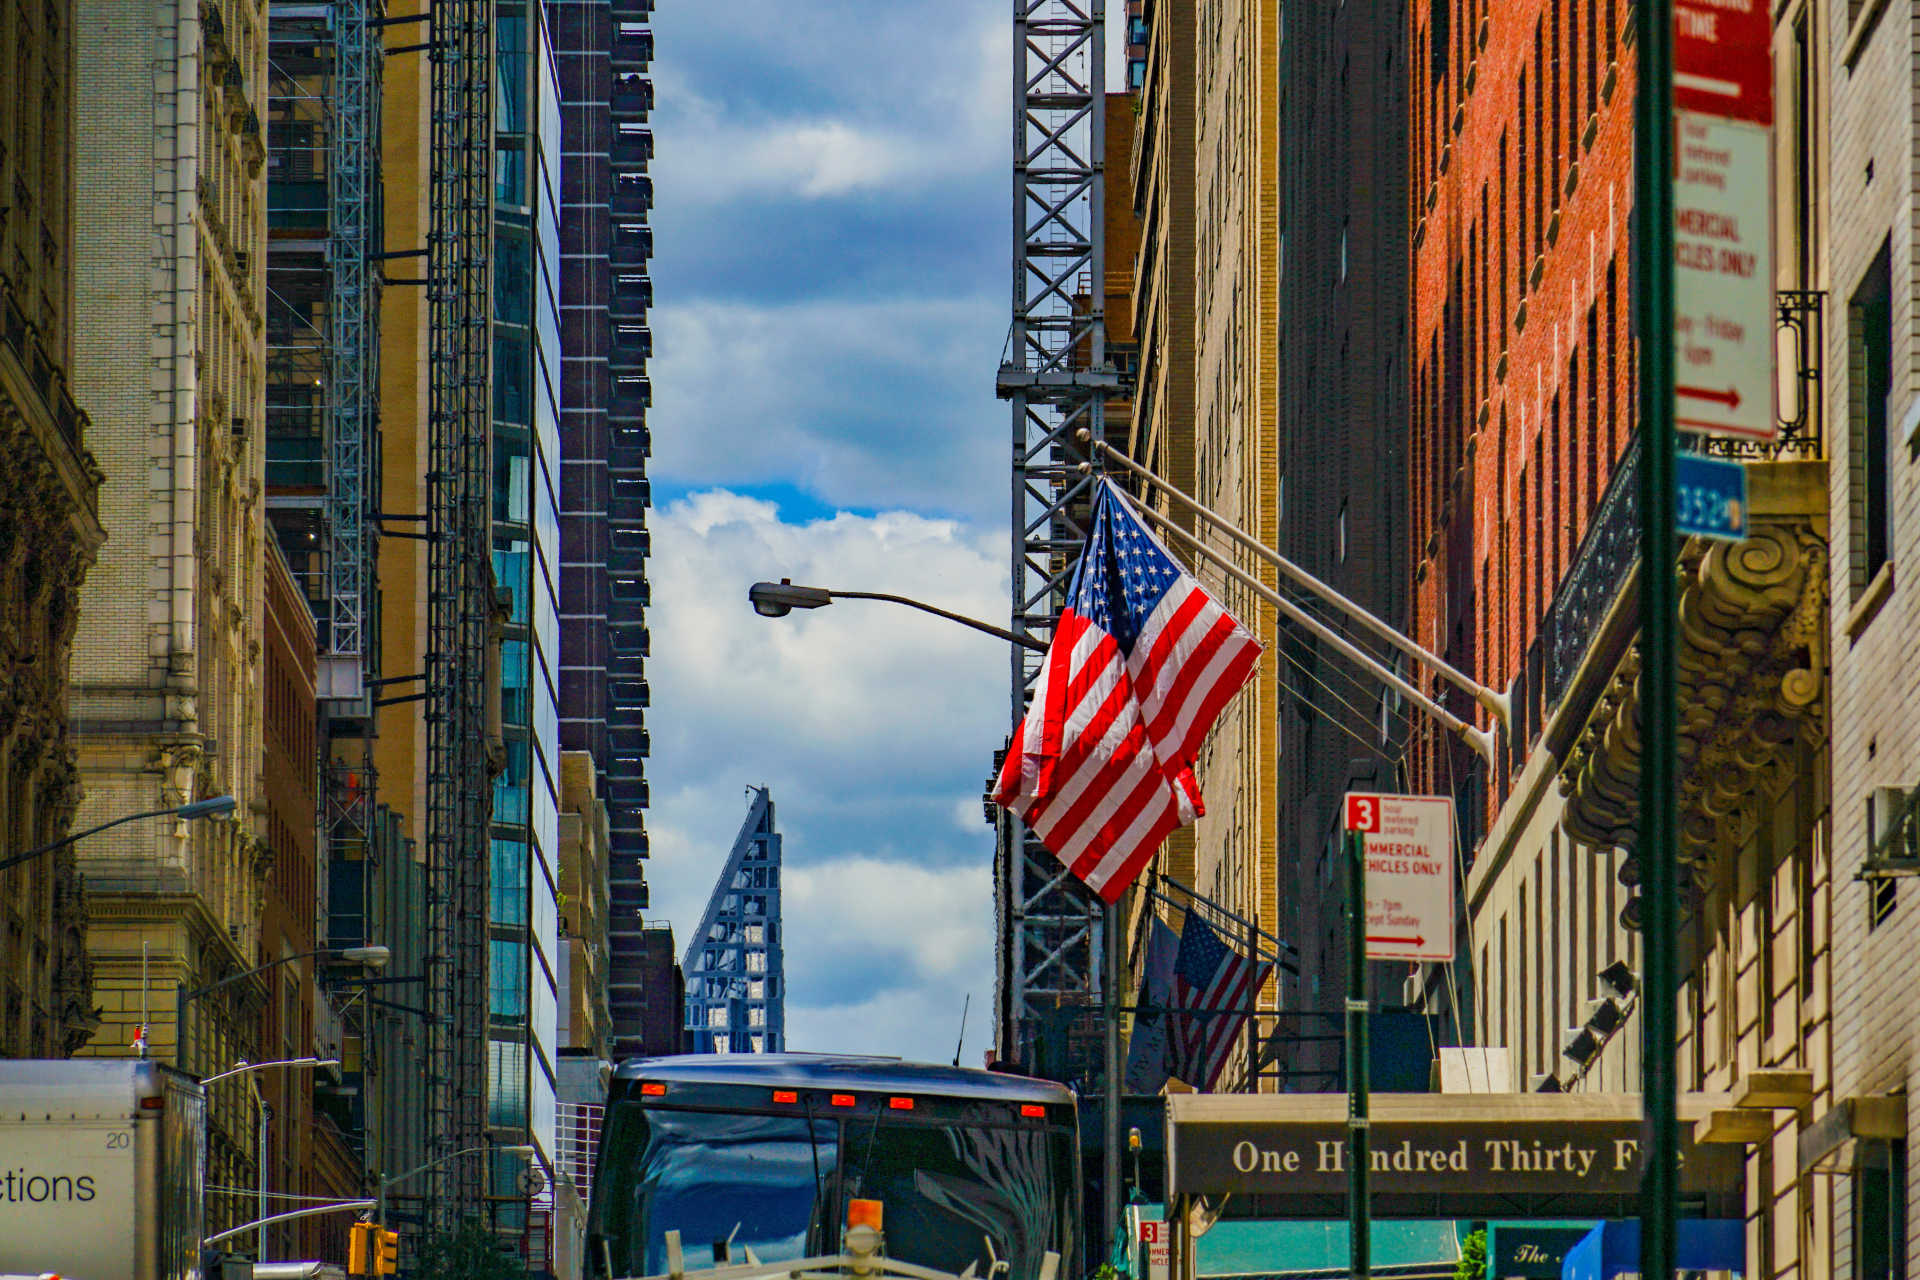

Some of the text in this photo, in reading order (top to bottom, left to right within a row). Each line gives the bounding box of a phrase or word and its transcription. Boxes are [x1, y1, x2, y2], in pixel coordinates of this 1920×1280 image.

[1674, 207, 1740, 242] MERCIAL
[1718, 247, 1758, 278] ONLY
[1356, 799, 1373, 830] 3
[1383, 804, 1403, 814] hour
[1383, 815, 1419, 825] metered
[1383, 827, 1415, 837] parking
[1364, 843, 1430, 858] OMMERCIAL
[1412, 862, 1442, 875] ONLY
[1382, 898, 1402, 911] 7pm
[1387, 913, 1420, 929] Sunday
[106, 1132, 130, 1149] 20
[1233, 1140, 1300, 1172] One
[1316, 1139, 1469, 1172] Hndred
[1485, 1139, 1597, 1177] Thirty
[0, 1168, 96, 1202] tions
[1144, 1223, 1154, 1242] 3
[1513, 1244, 1549, 1263] The
